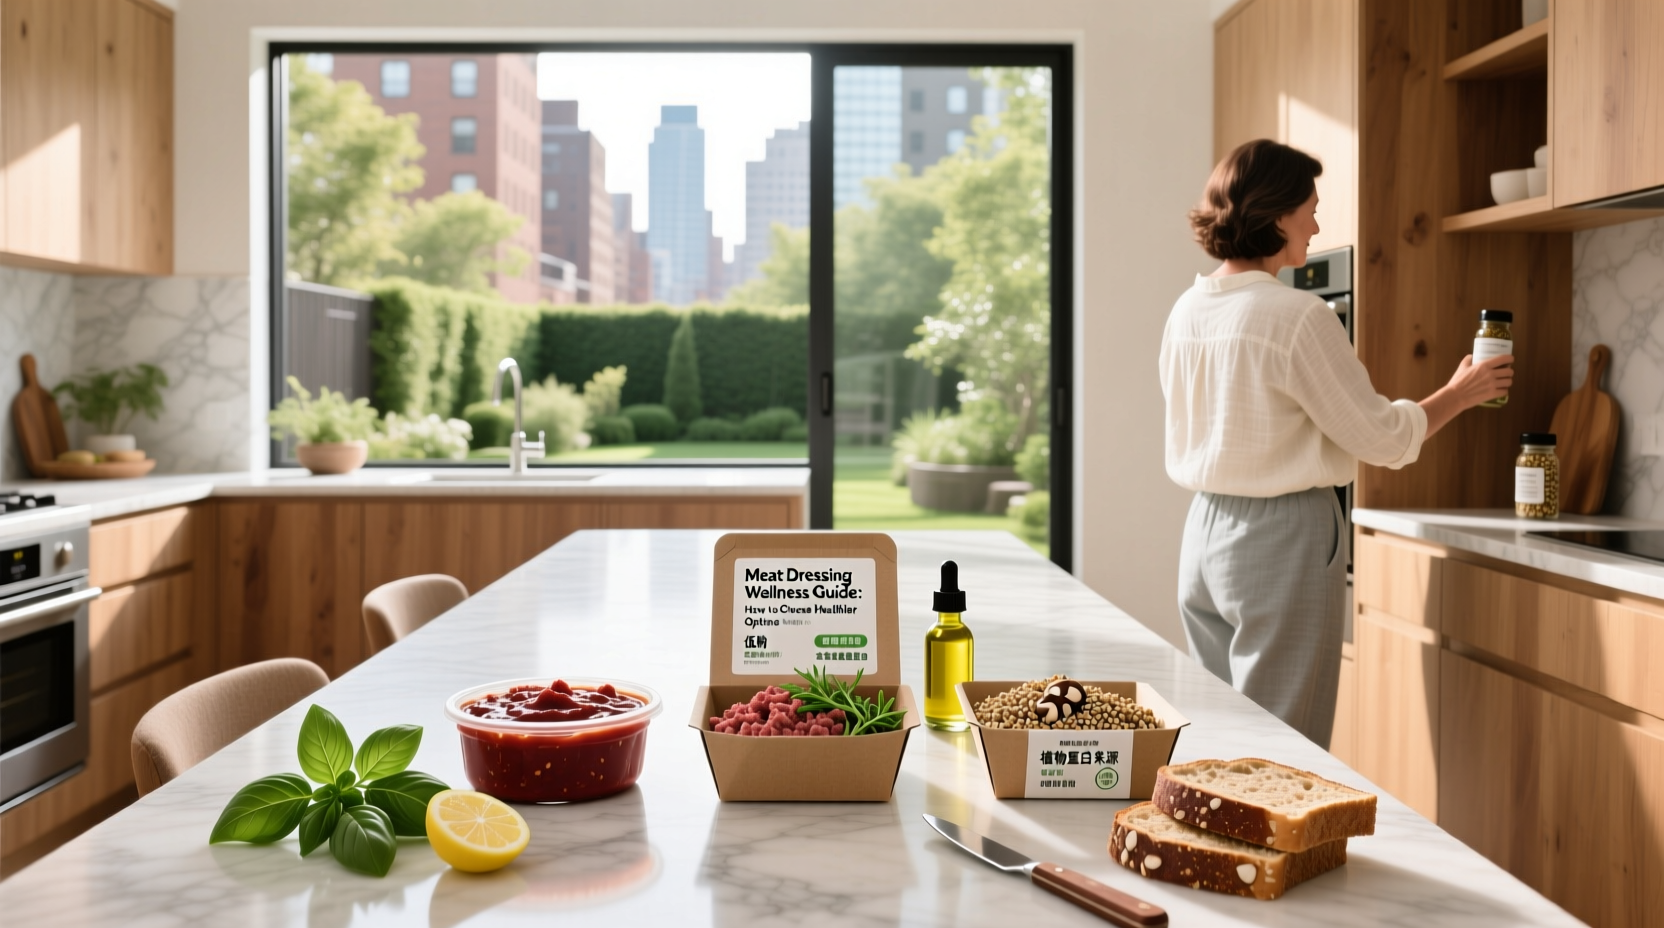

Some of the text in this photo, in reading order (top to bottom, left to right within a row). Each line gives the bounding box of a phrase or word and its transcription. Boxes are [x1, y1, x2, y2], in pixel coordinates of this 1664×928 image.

[745, 568, 852, 586] Meat Dressing
[745, 584, 862, 599] Wellness Guide:
